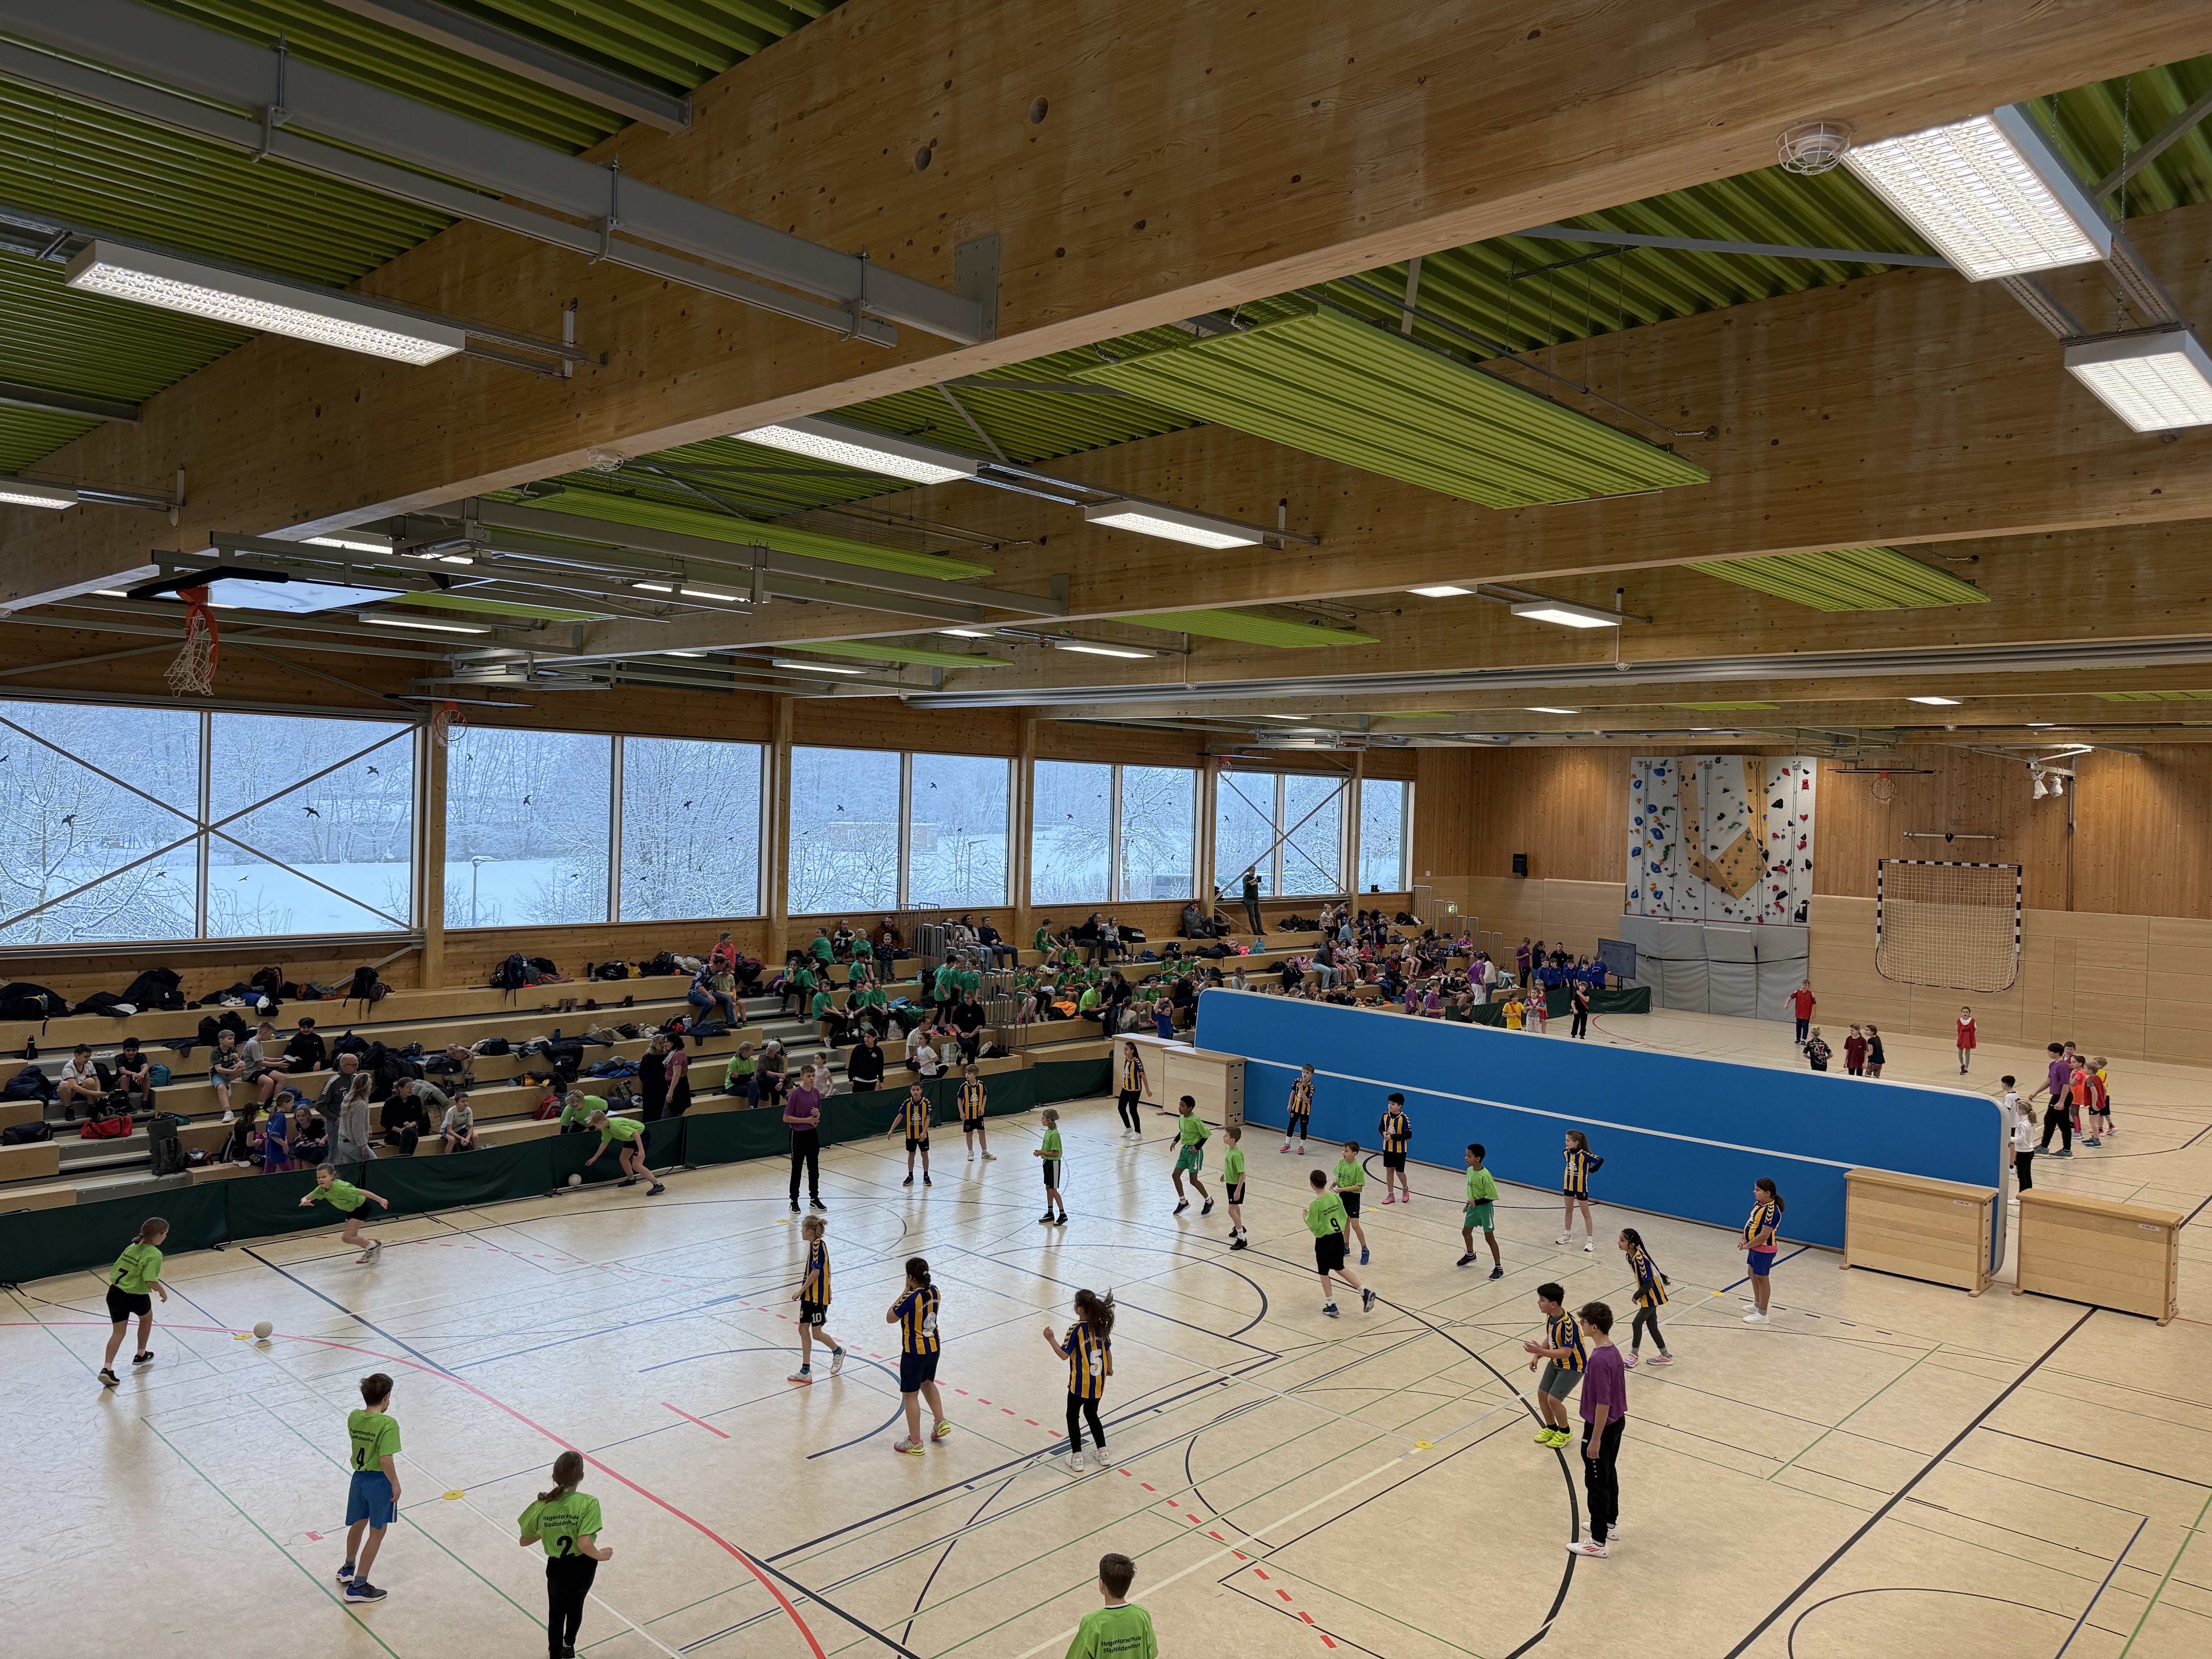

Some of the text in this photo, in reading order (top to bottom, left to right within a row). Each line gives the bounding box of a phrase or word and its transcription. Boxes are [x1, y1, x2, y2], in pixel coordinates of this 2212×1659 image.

[1330, 1218, 1341, 1232] 9
[115, 1267, 129, 1285] 7
[812, 1313, 822, 1323] 10
[922, 1312, 936, 1337] 9
[1090, 1349, 1103, 1376] 5
[356, 1447, 365, 1470] 4
[557, 1535, 575, 1559] 2
